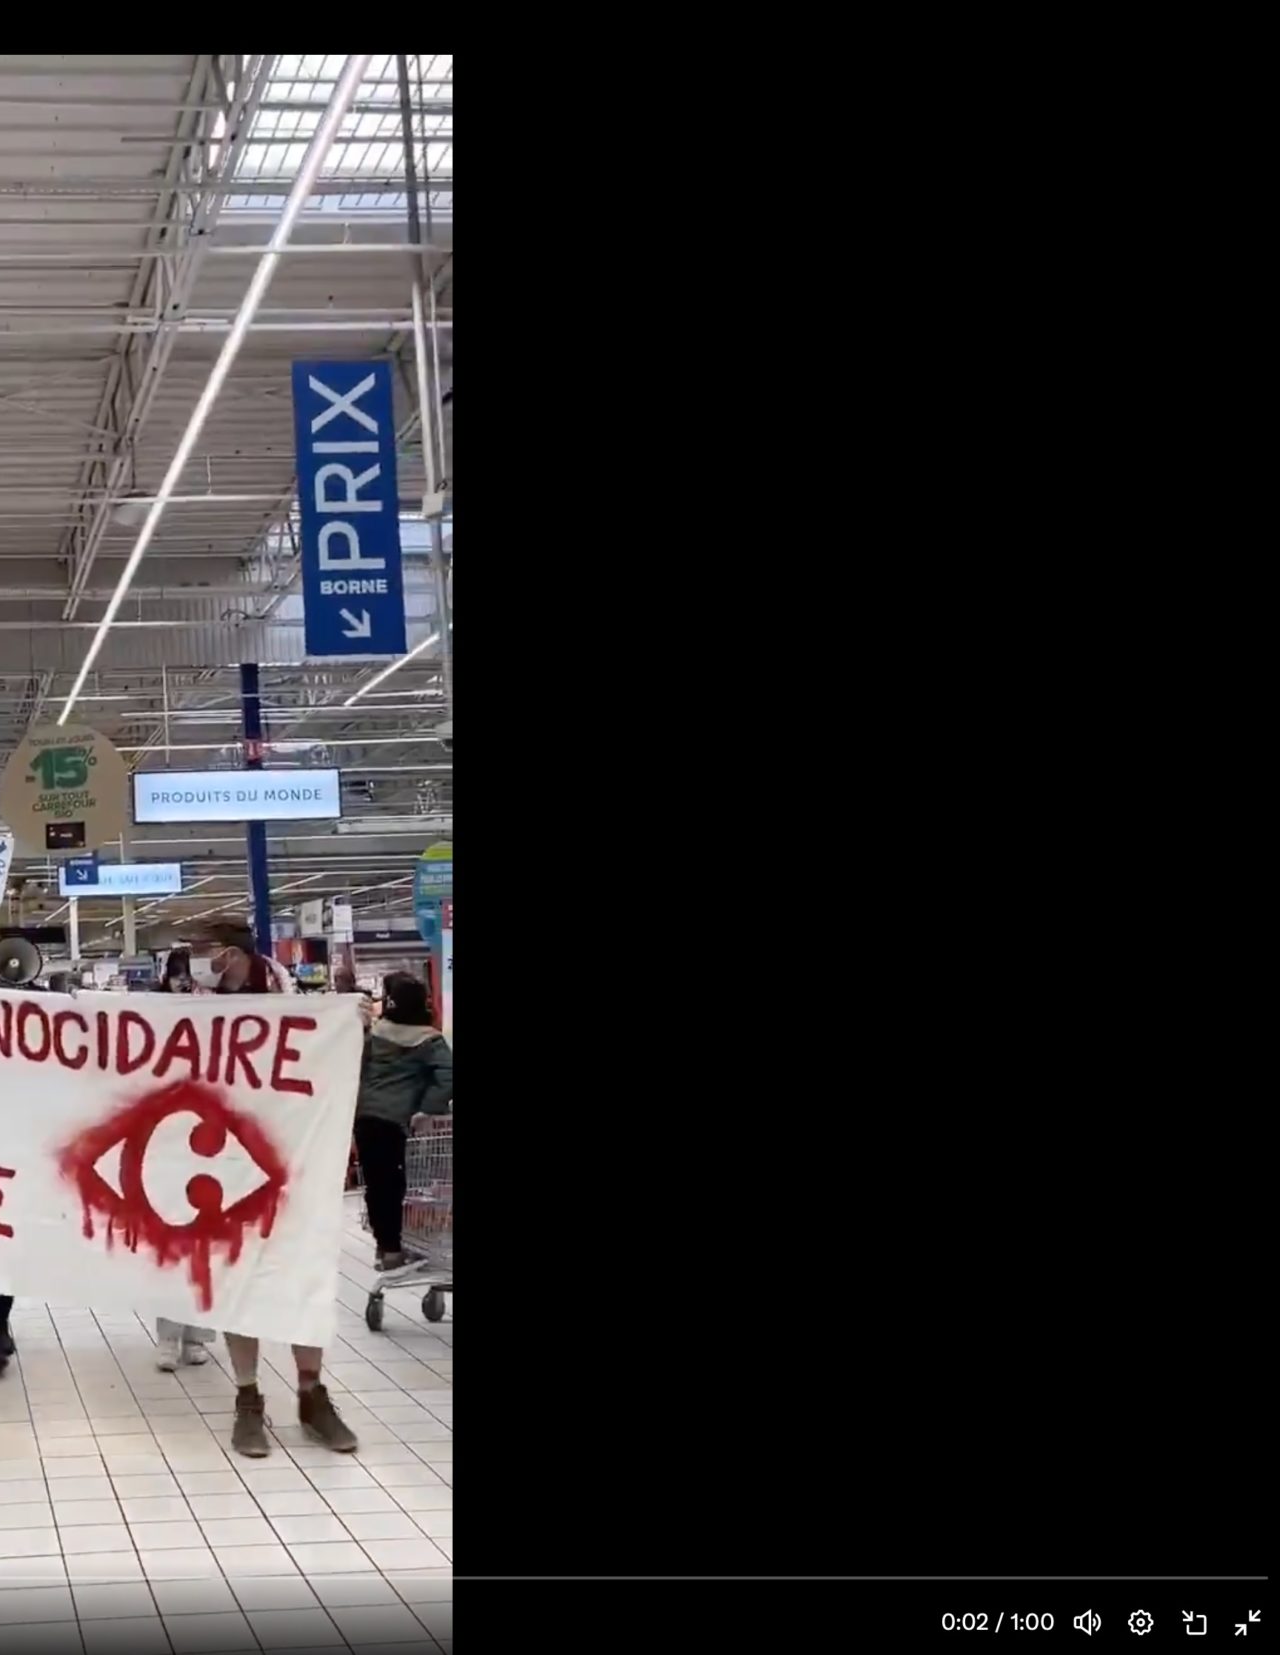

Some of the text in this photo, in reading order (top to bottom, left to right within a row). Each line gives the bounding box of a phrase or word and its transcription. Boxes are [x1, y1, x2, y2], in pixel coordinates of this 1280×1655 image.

[308, 372, 385, 571] PRIX
[320, 579, 388, 595] BORNE
[62, 790, 89, 801] TOUT
[151, 787, 322, 804] PRODUITS DU MONDE
[32, 798, 97, 812] CARREFOUR
